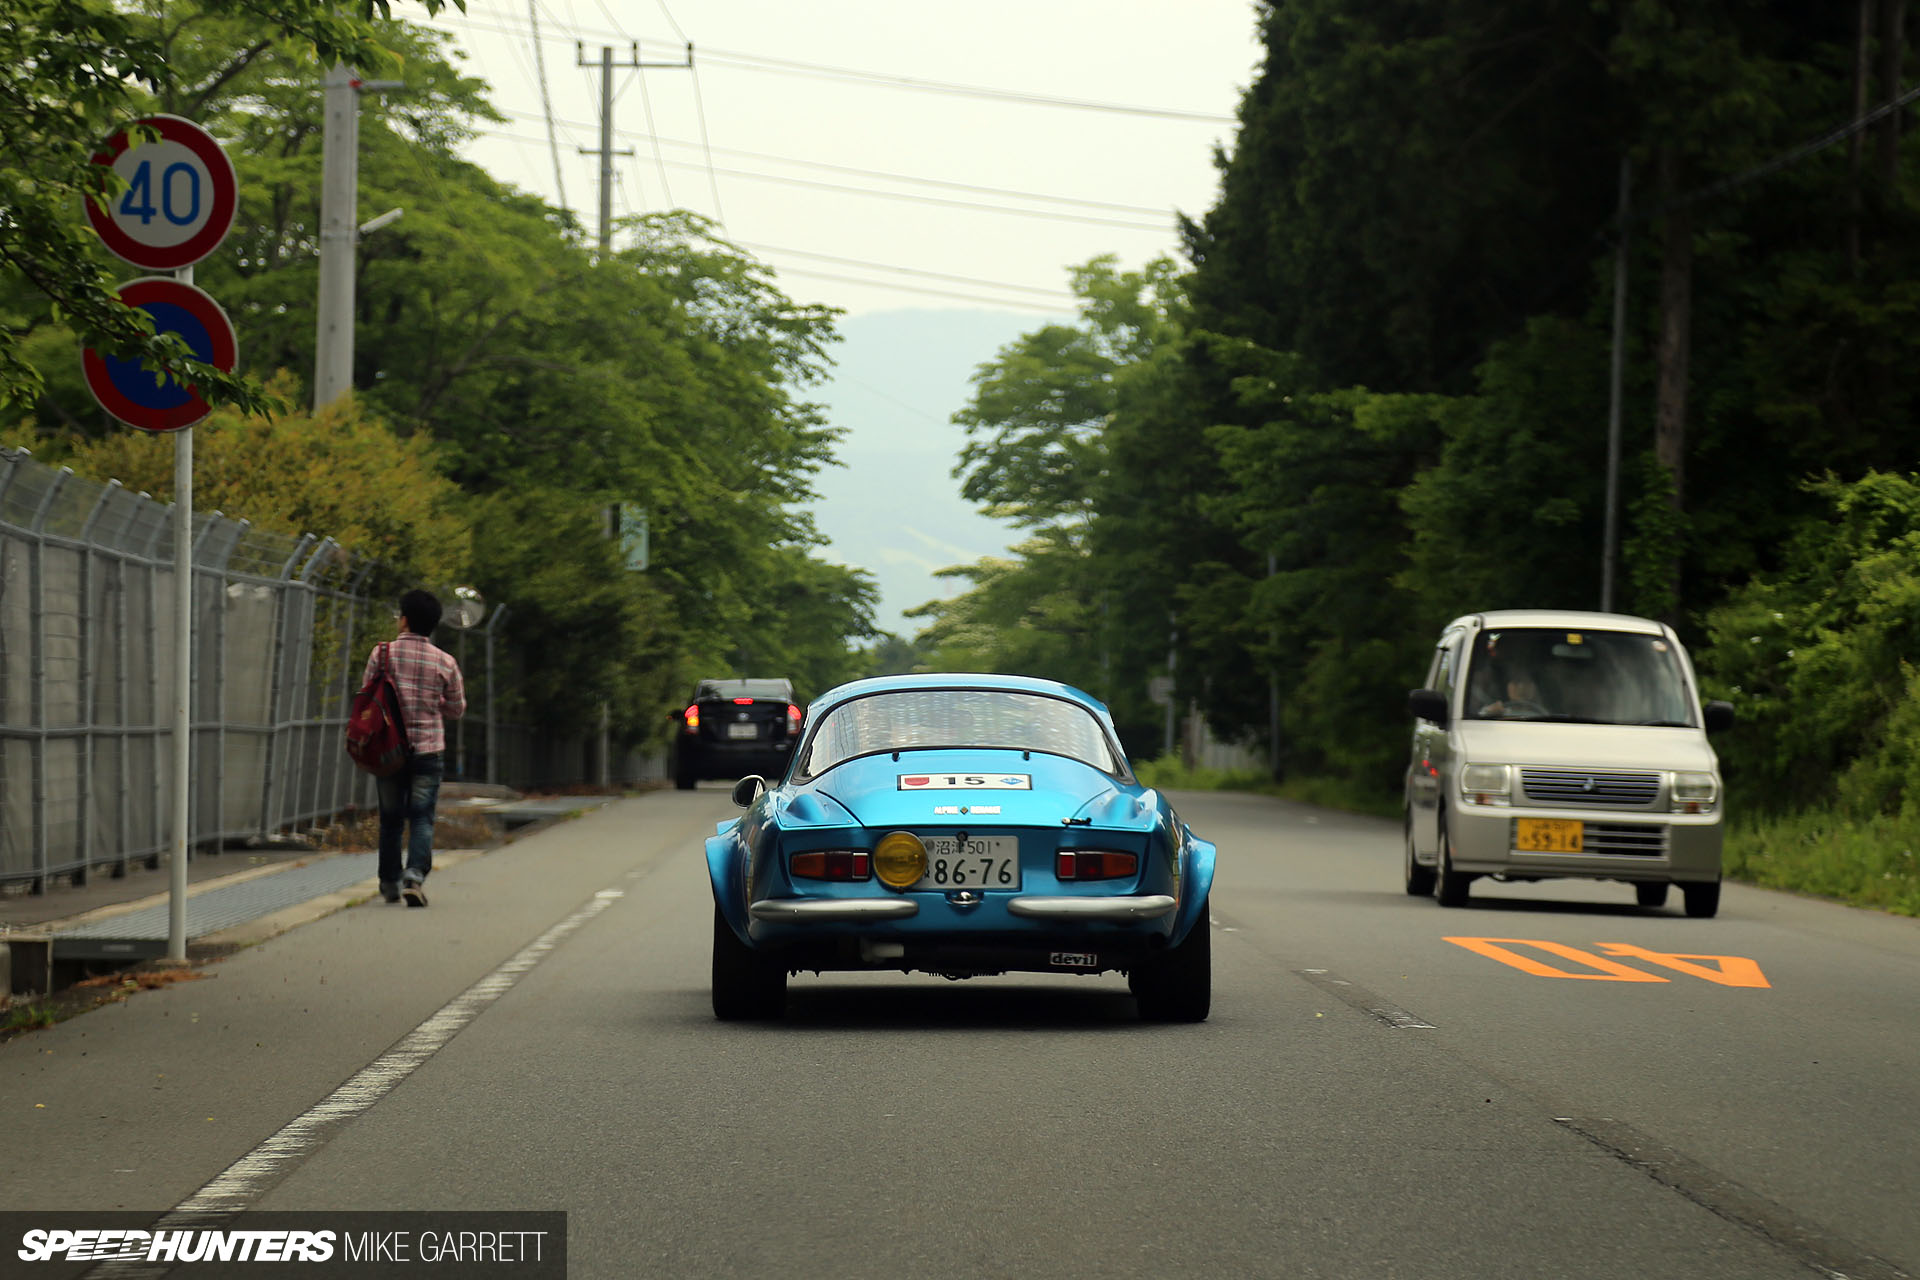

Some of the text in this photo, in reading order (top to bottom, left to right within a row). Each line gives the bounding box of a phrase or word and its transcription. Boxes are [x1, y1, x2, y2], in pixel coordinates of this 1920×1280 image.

[120, 160, 200, 226] 40
[943, 776, 985, 785] 15
[934, 858, 1012, 884] 86-76
[1052, 953, 1096, 965] devil
